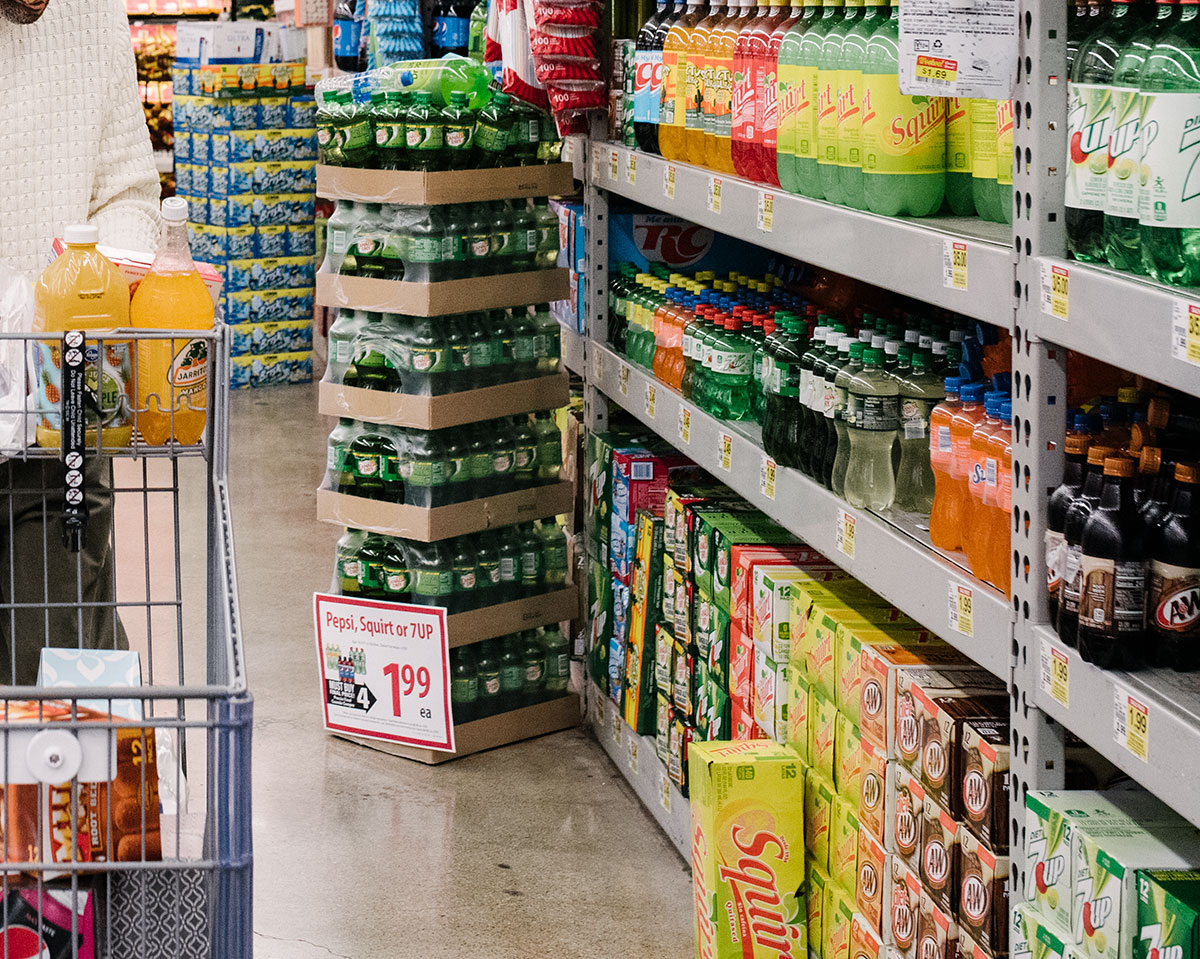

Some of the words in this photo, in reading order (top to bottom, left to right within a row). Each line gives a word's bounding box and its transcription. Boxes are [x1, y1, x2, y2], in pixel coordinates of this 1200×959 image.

[533, 37, 549, 46] 100
[540, 63, 555, 72] 100
[921, 68, 948, 81] $1.69
[553, 93, 569, 103] 100
[892, 97, 945, 145] Squir
[778, 585, 790, 596] 12
[959, 594, 972, 614] 1.99
[326, 611, 358, 633] Pepsi,
[360, 616, 394, 637] Squirt
[396, 623, 409, 637] or
[410, 623, 434, 640] 7UP
[1052, 658, 1068, 682] 1.99
[356, 687, 370, 710] 4
[420, 707, 432, 719] ea
[1129, 709, 1147, 734] 1.99
[132, 739, 142, 766] 12
[785, 762, 797, 780] 12
[965, 780, 987, 807] A&W
[91, 814, 99, 846] ROOT
[1030, 829, 1042, 840] DIET
[1063, 825, 1071, 841] 12
[928, 849, 947, 877] A&W
[1027, 839, 1065, 902] 7UP
[1078, 868, 1089, 878] DIET
[718, 823, 800, 959] Squir
[964, 883, 987, 911] A&W
[1139, 878, 1150, 896] 12
[1013, 911, 1023, 928] 12
[1075, 877, 1112, 946] 7UP
[1014, 942, 1028, 951] DIET
